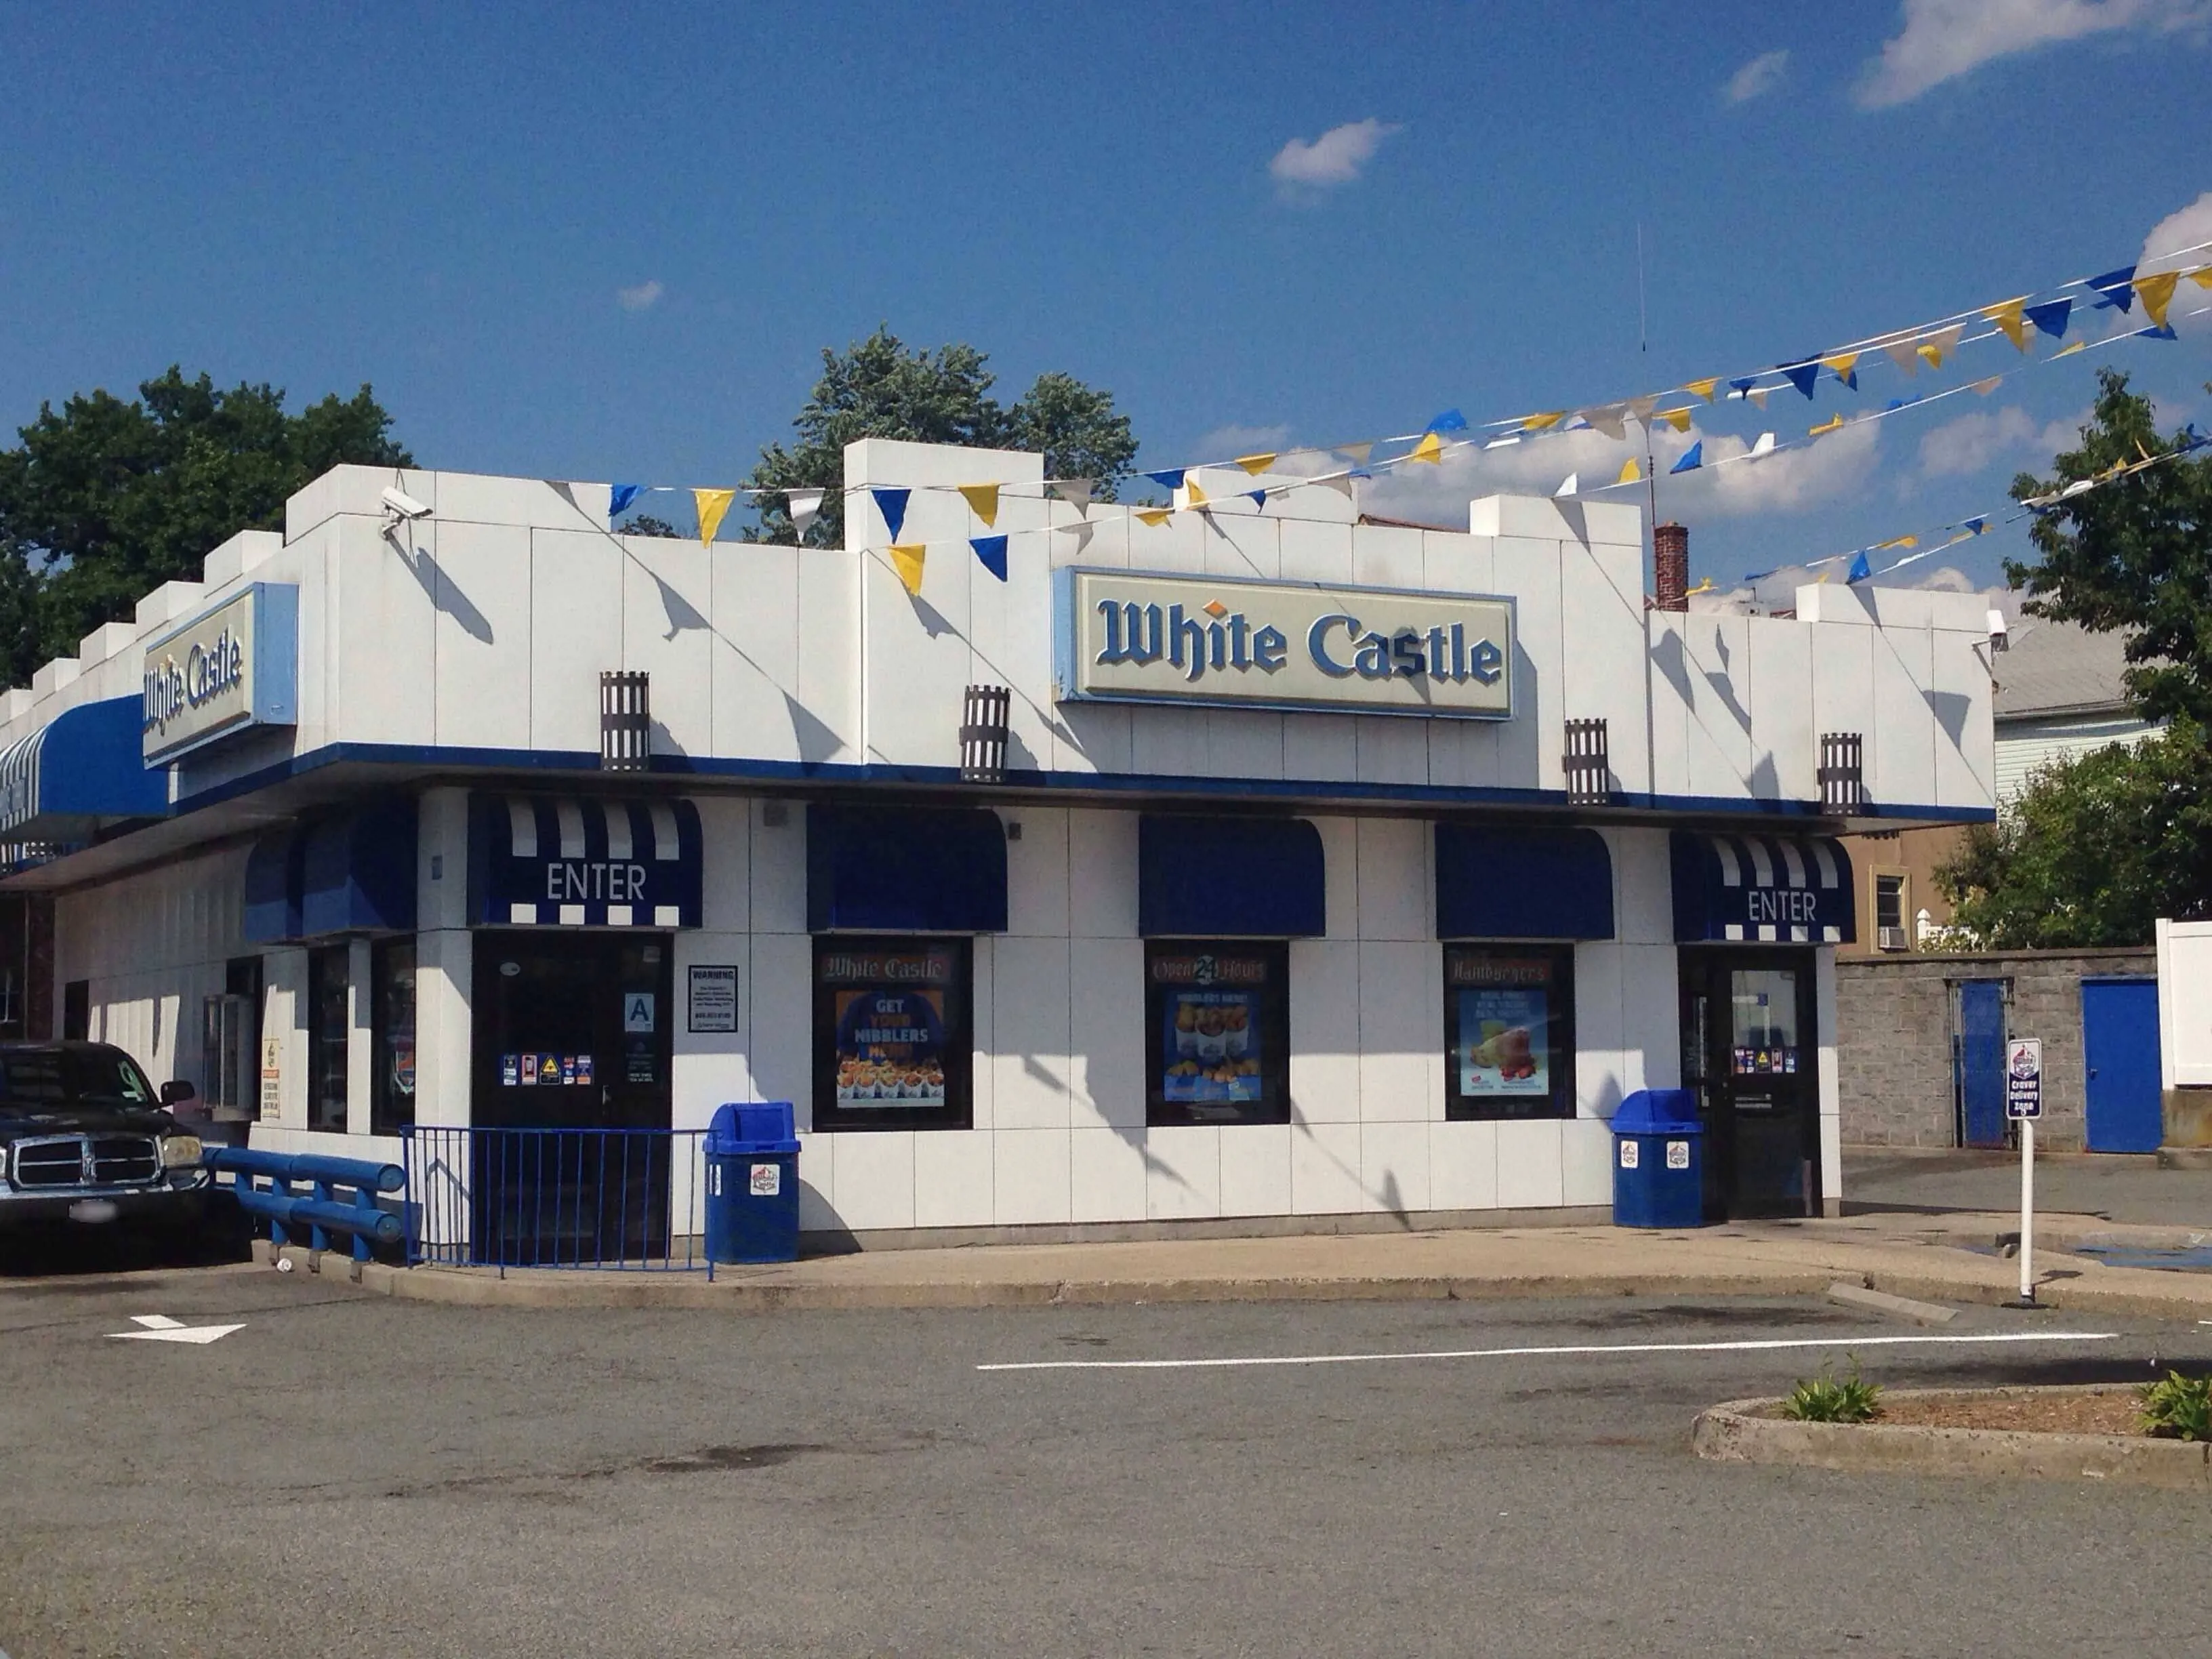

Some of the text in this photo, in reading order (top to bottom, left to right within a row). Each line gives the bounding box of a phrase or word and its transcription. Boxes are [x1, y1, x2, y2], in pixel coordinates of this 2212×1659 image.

[1095, 598, 1502, 685] White Castle
[144, 625, 242, 737] White Castle
[548, 863, 646, 900] ENTER
[1748, 891, 1816, 921] ENTER
[693, 970, 733, 979] WARNING
[824, 957, 943, 981] White Castle
[1153, 958, 1265, 980] Open 24 Hours
[1453, 960, 1545, 982] Hamburgers
[630, 998, 649, 1021] A
[876, 999, 904, 1014] GET
[855, 1028, 928, 1043] NIBBLERS
